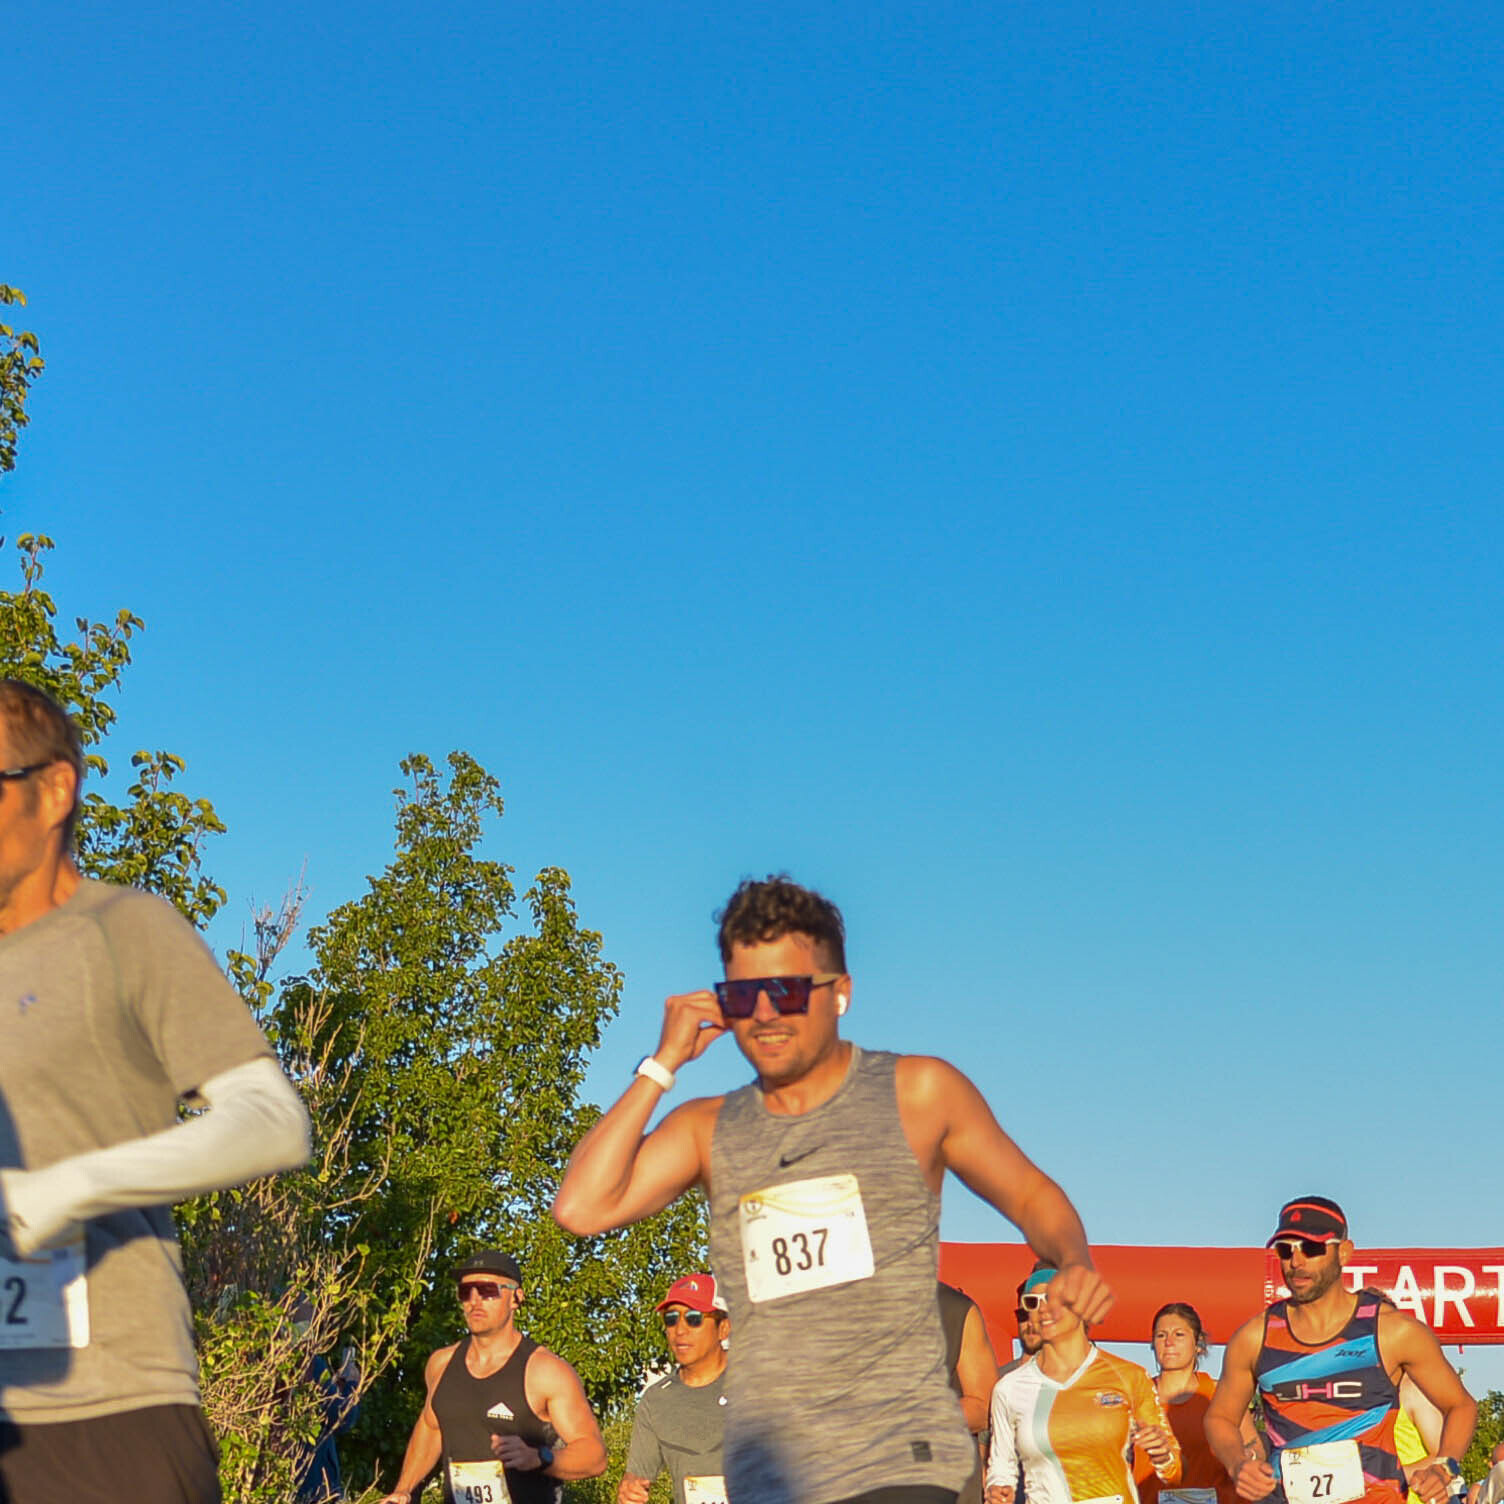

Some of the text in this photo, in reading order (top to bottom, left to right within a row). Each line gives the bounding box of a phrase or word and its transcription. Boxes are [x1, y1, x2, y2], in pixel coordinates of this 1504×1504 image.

[772, 1228, 828, 1276] 837
[465, 1484, 494, 1504] 493
[1310, 1473, 1334, 1498] 27
